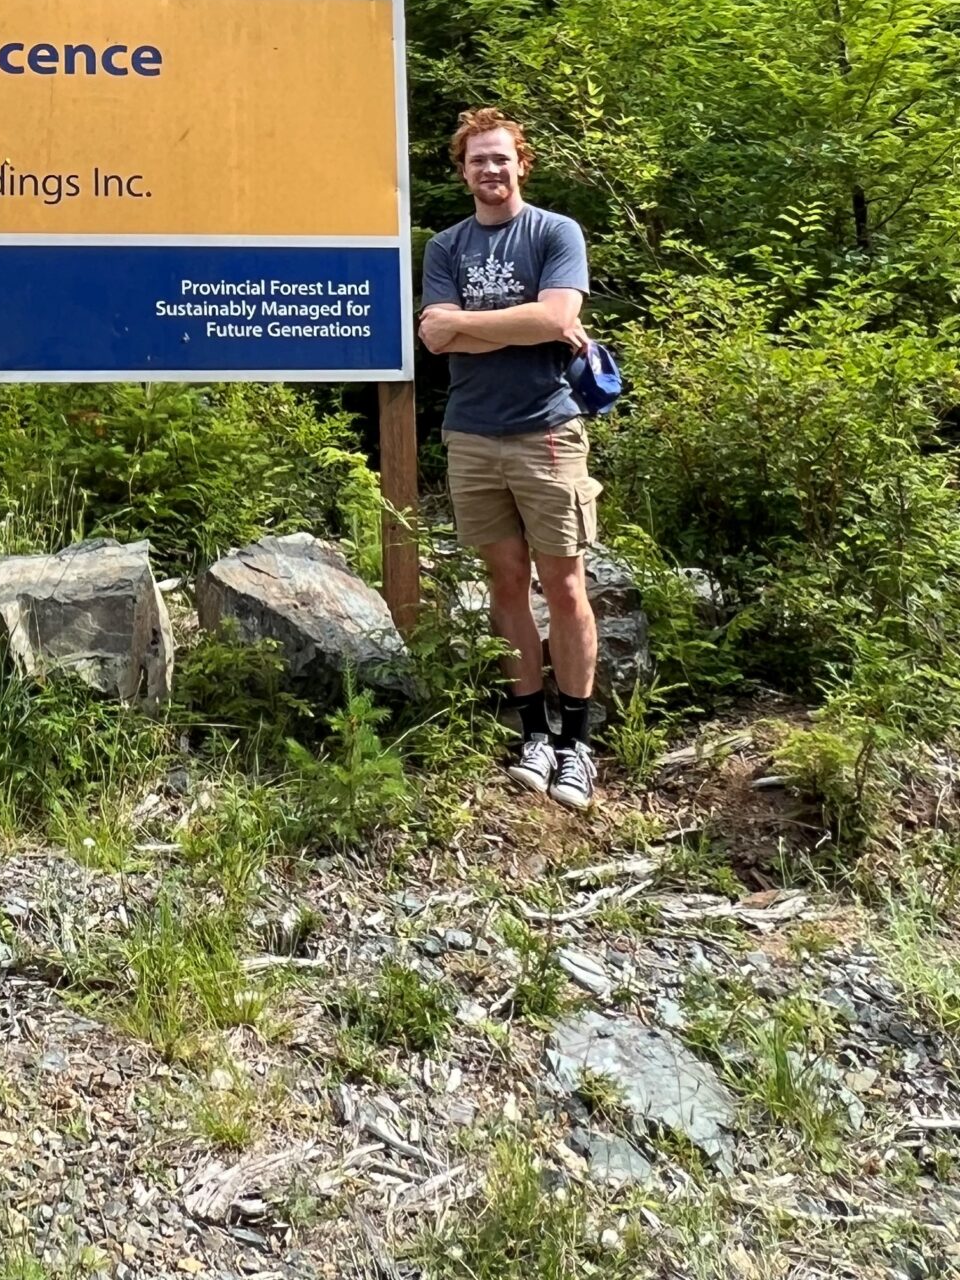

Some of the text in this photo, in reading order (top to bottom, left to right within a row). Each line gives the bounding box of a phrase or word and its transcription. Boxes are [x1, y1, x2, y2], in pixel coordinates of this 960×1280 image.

[94, 167, 152, 197] Inc.
[181, 279, 370, 296] Provincial Forest Land
[155, 300, 370, 320] Sustainably Managed for
[206, 322, 371, 337] Future Generations
